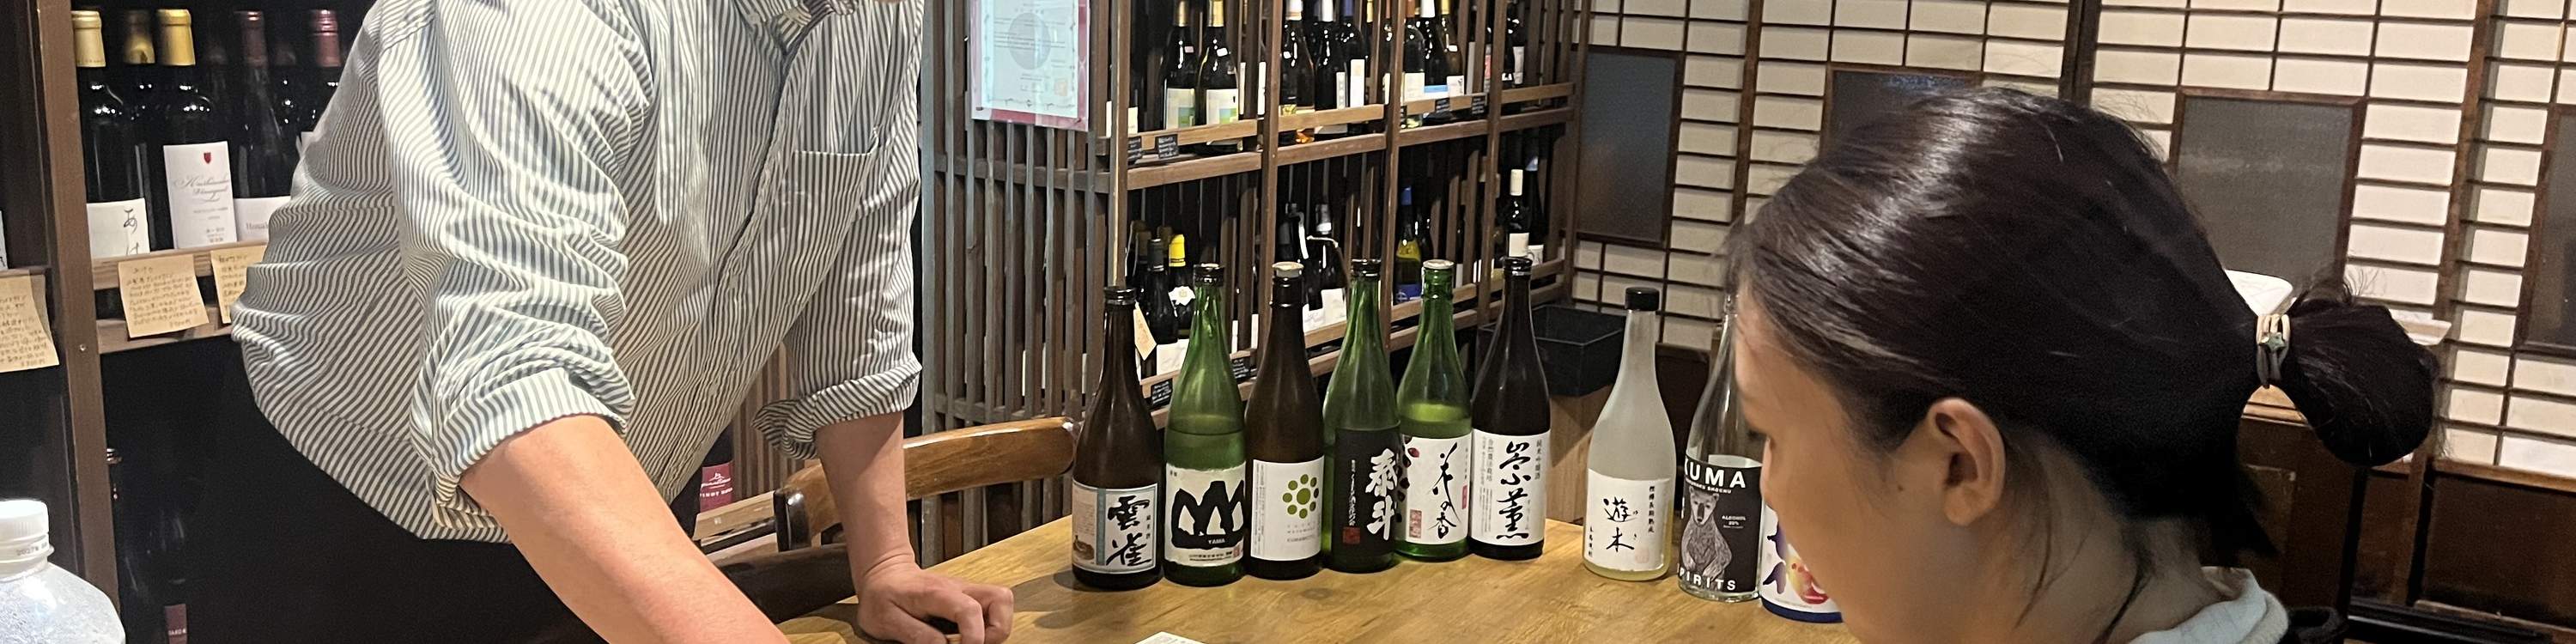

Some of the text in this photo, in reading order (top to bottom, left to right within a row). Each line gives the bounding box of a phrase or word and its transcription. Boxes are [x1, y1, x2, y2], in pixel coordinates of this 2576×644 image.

[1106, 495, 1151, 567] 雲雀
[1426, 442, 1461, 539] 花の香
